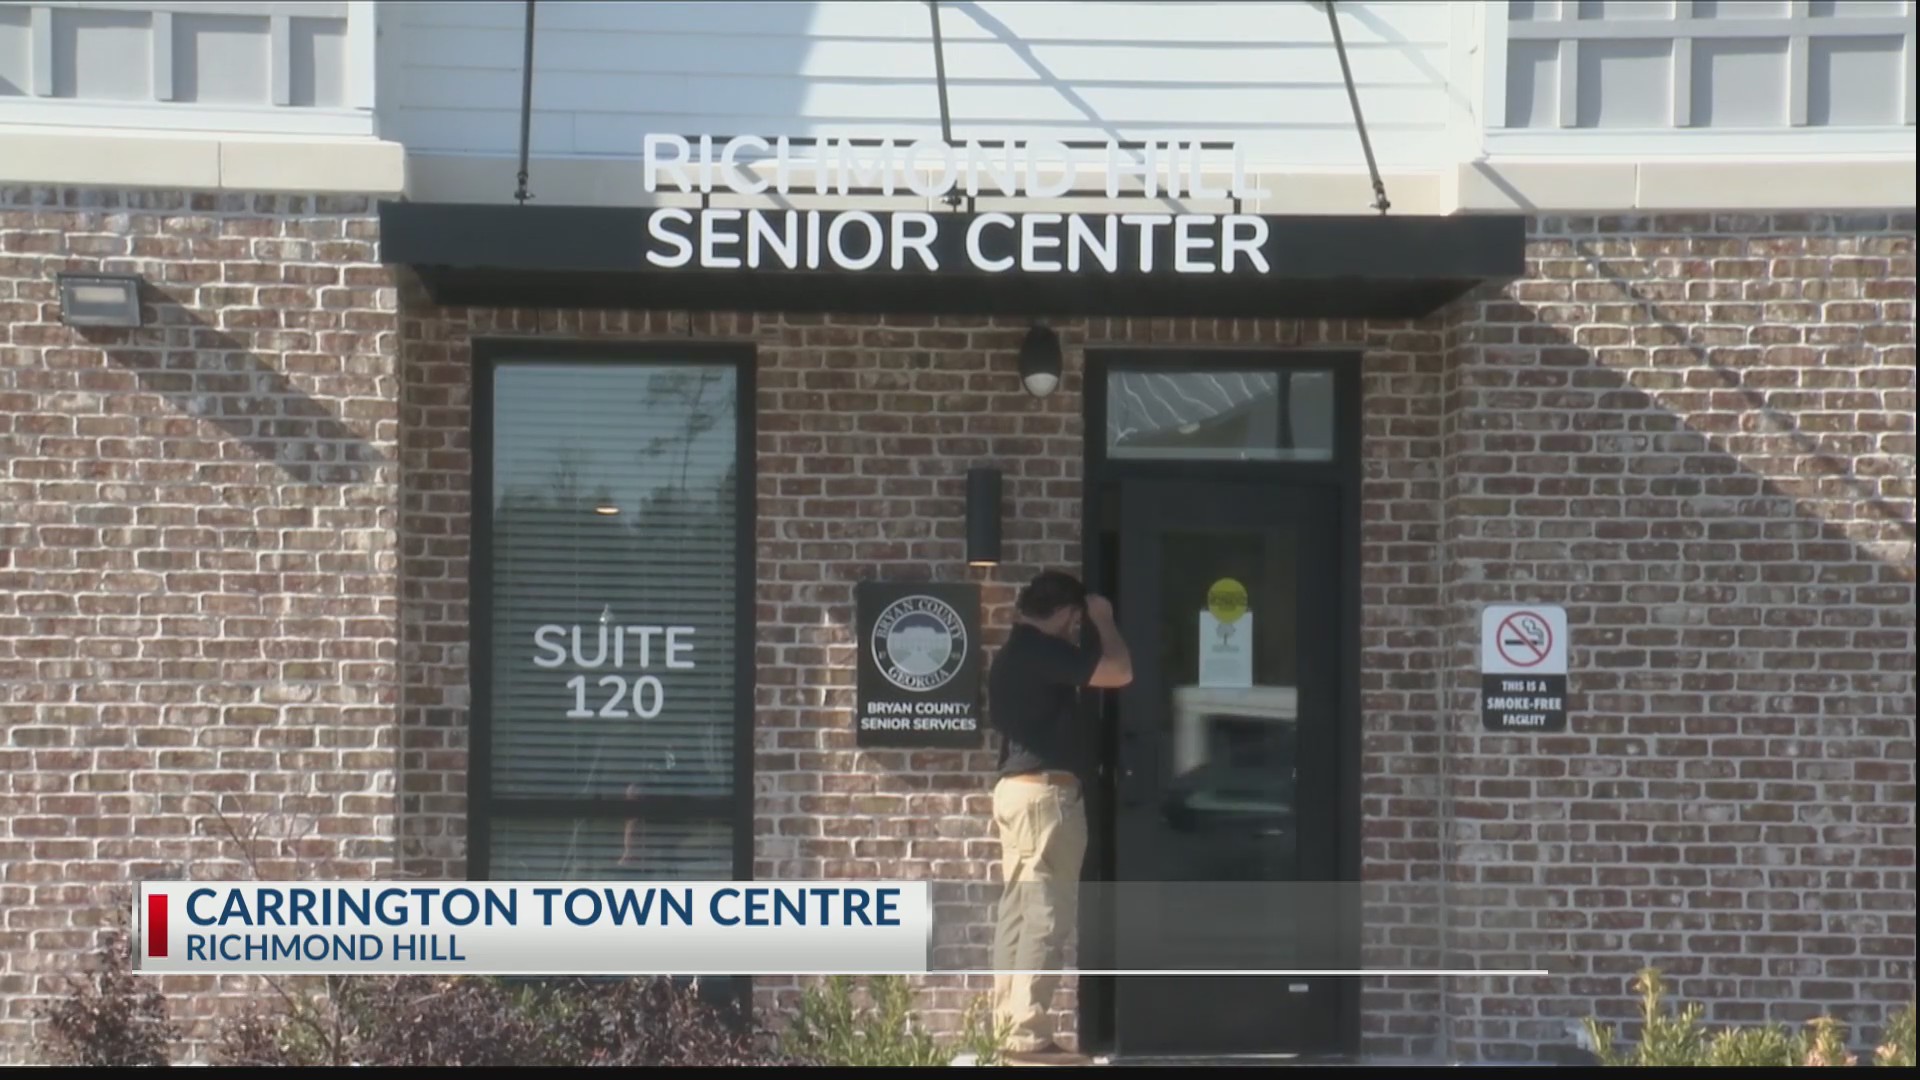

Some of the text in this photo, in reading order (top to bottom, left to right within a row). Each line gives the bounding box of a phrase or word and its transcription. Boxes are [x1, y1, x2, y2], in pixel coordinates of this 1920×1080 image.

[643, 133, 1272, 199] RICHMOND HILL
[646, 208, 1270, 274] SENIOR CENTER
[876, 600, 964, 640] BRYAN COUNTY
[533, 624, 696, 668] SUITE
[887, 666, 950, 688] GEORGIA
[1502, 681, 1547, 692] THIS IS A
[566, 675, 664, 719] 120
[1487, 697, 1562, 710] SMOKE-FREE
[867, 702, 971, 715] BRYAN COUNTY
[861, 718, 977, 731] SENIOR SERVICES
[1502, 714, 1546, 726] FACILITY
